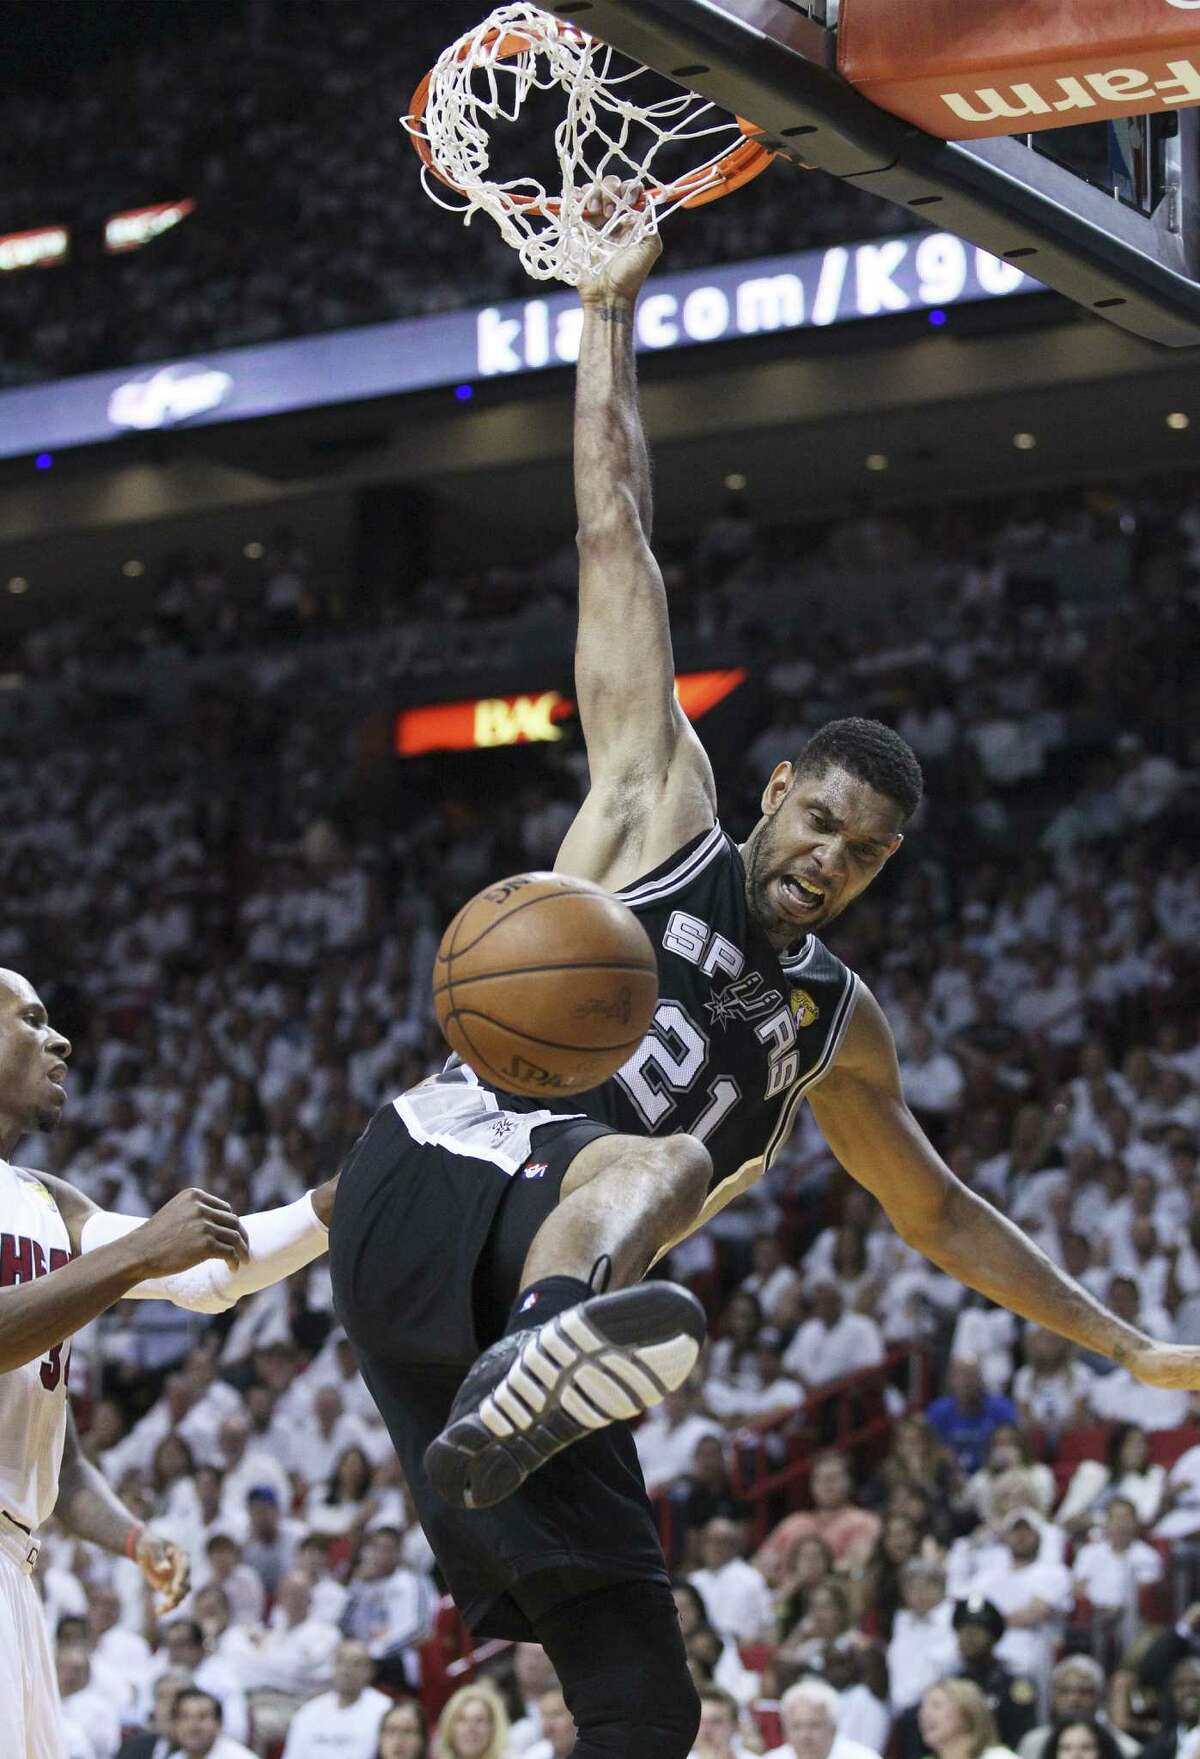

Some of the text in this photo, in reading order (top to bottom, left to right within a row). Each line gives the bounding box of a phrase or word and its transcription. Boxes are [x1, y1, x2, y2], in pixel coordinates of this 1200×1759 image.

[940, 60, 1200, 121] Farm
[662, 910, 801, 1101] SPURS
[613, 998, 743, 1144] 21
[0, 1233, 72, 1287] HE
